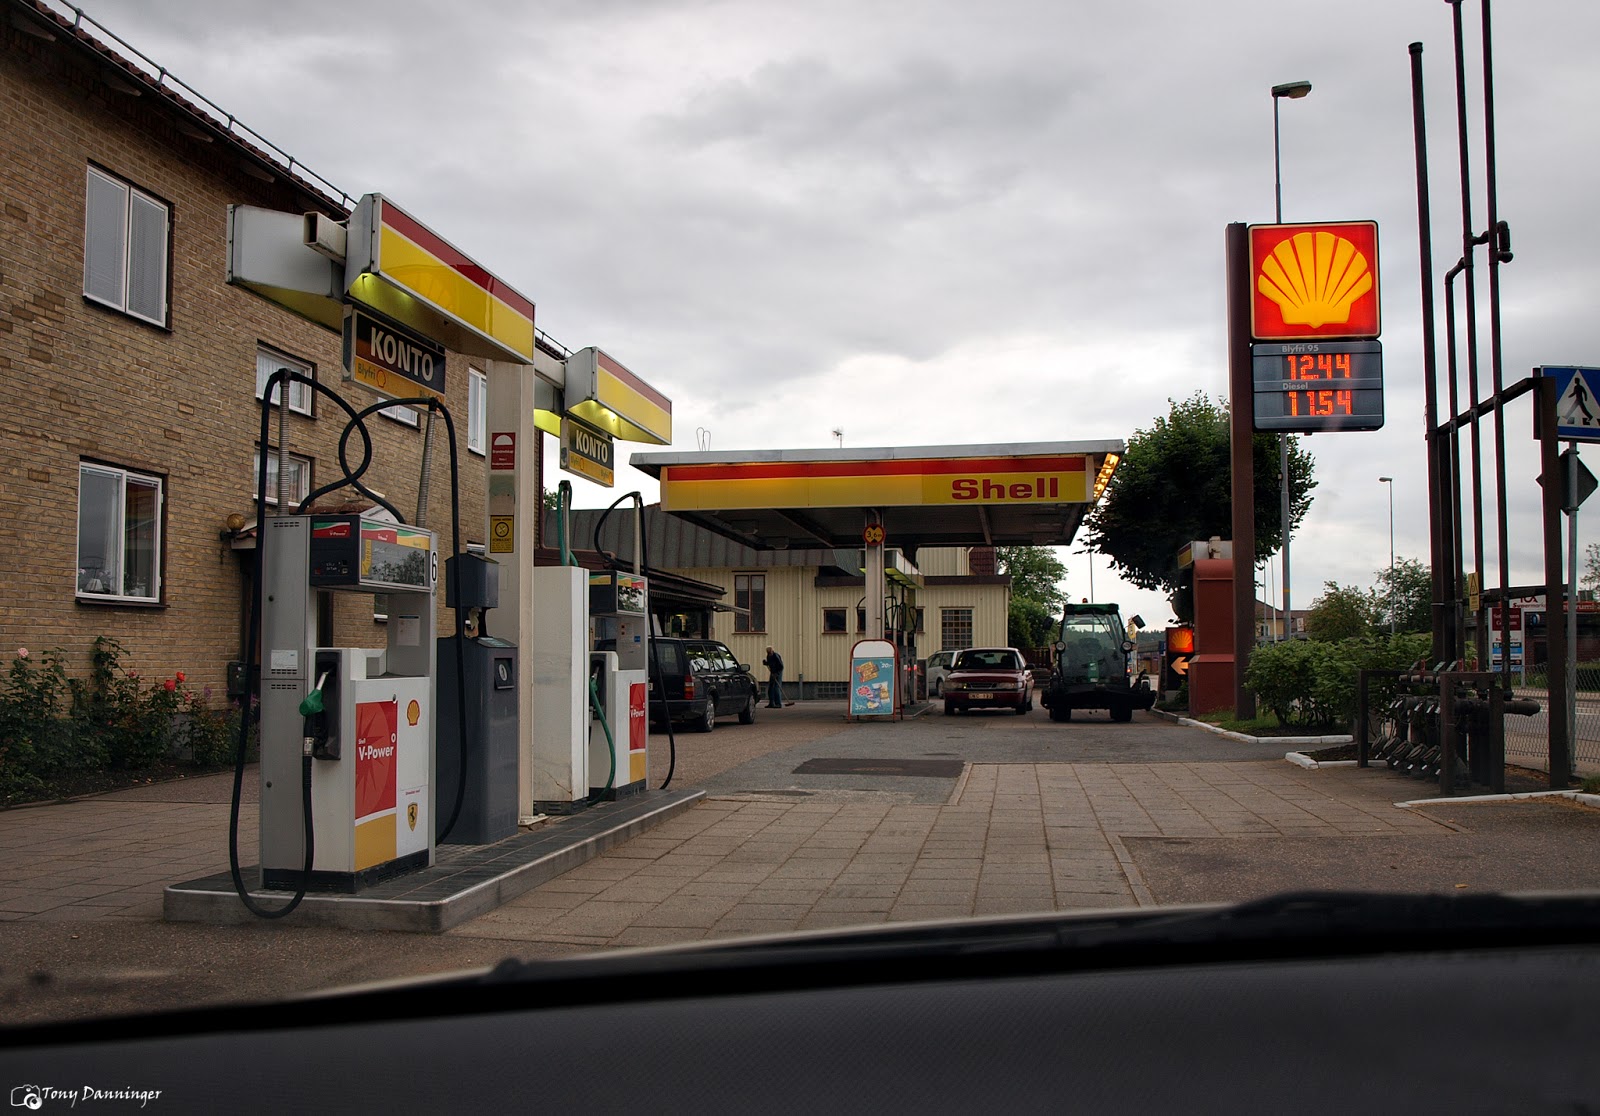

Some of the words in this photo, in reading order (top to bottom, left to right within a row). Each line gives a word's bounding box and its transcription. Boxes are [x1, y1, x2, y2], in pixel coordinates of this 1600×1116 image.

[371, 327, 434, 381] KONTO
[1282, 345, 1305, 354] Blyfri
[1307, 344, 1319, 352] 95
[1282, 382, 1308, 390] Diesel
[576, 429, 608, 463] KONTO
[951, 477, 1059, 500] Shell
[431, 551, 438, 582] 6
[358, 745, 394, 761] V-Power
